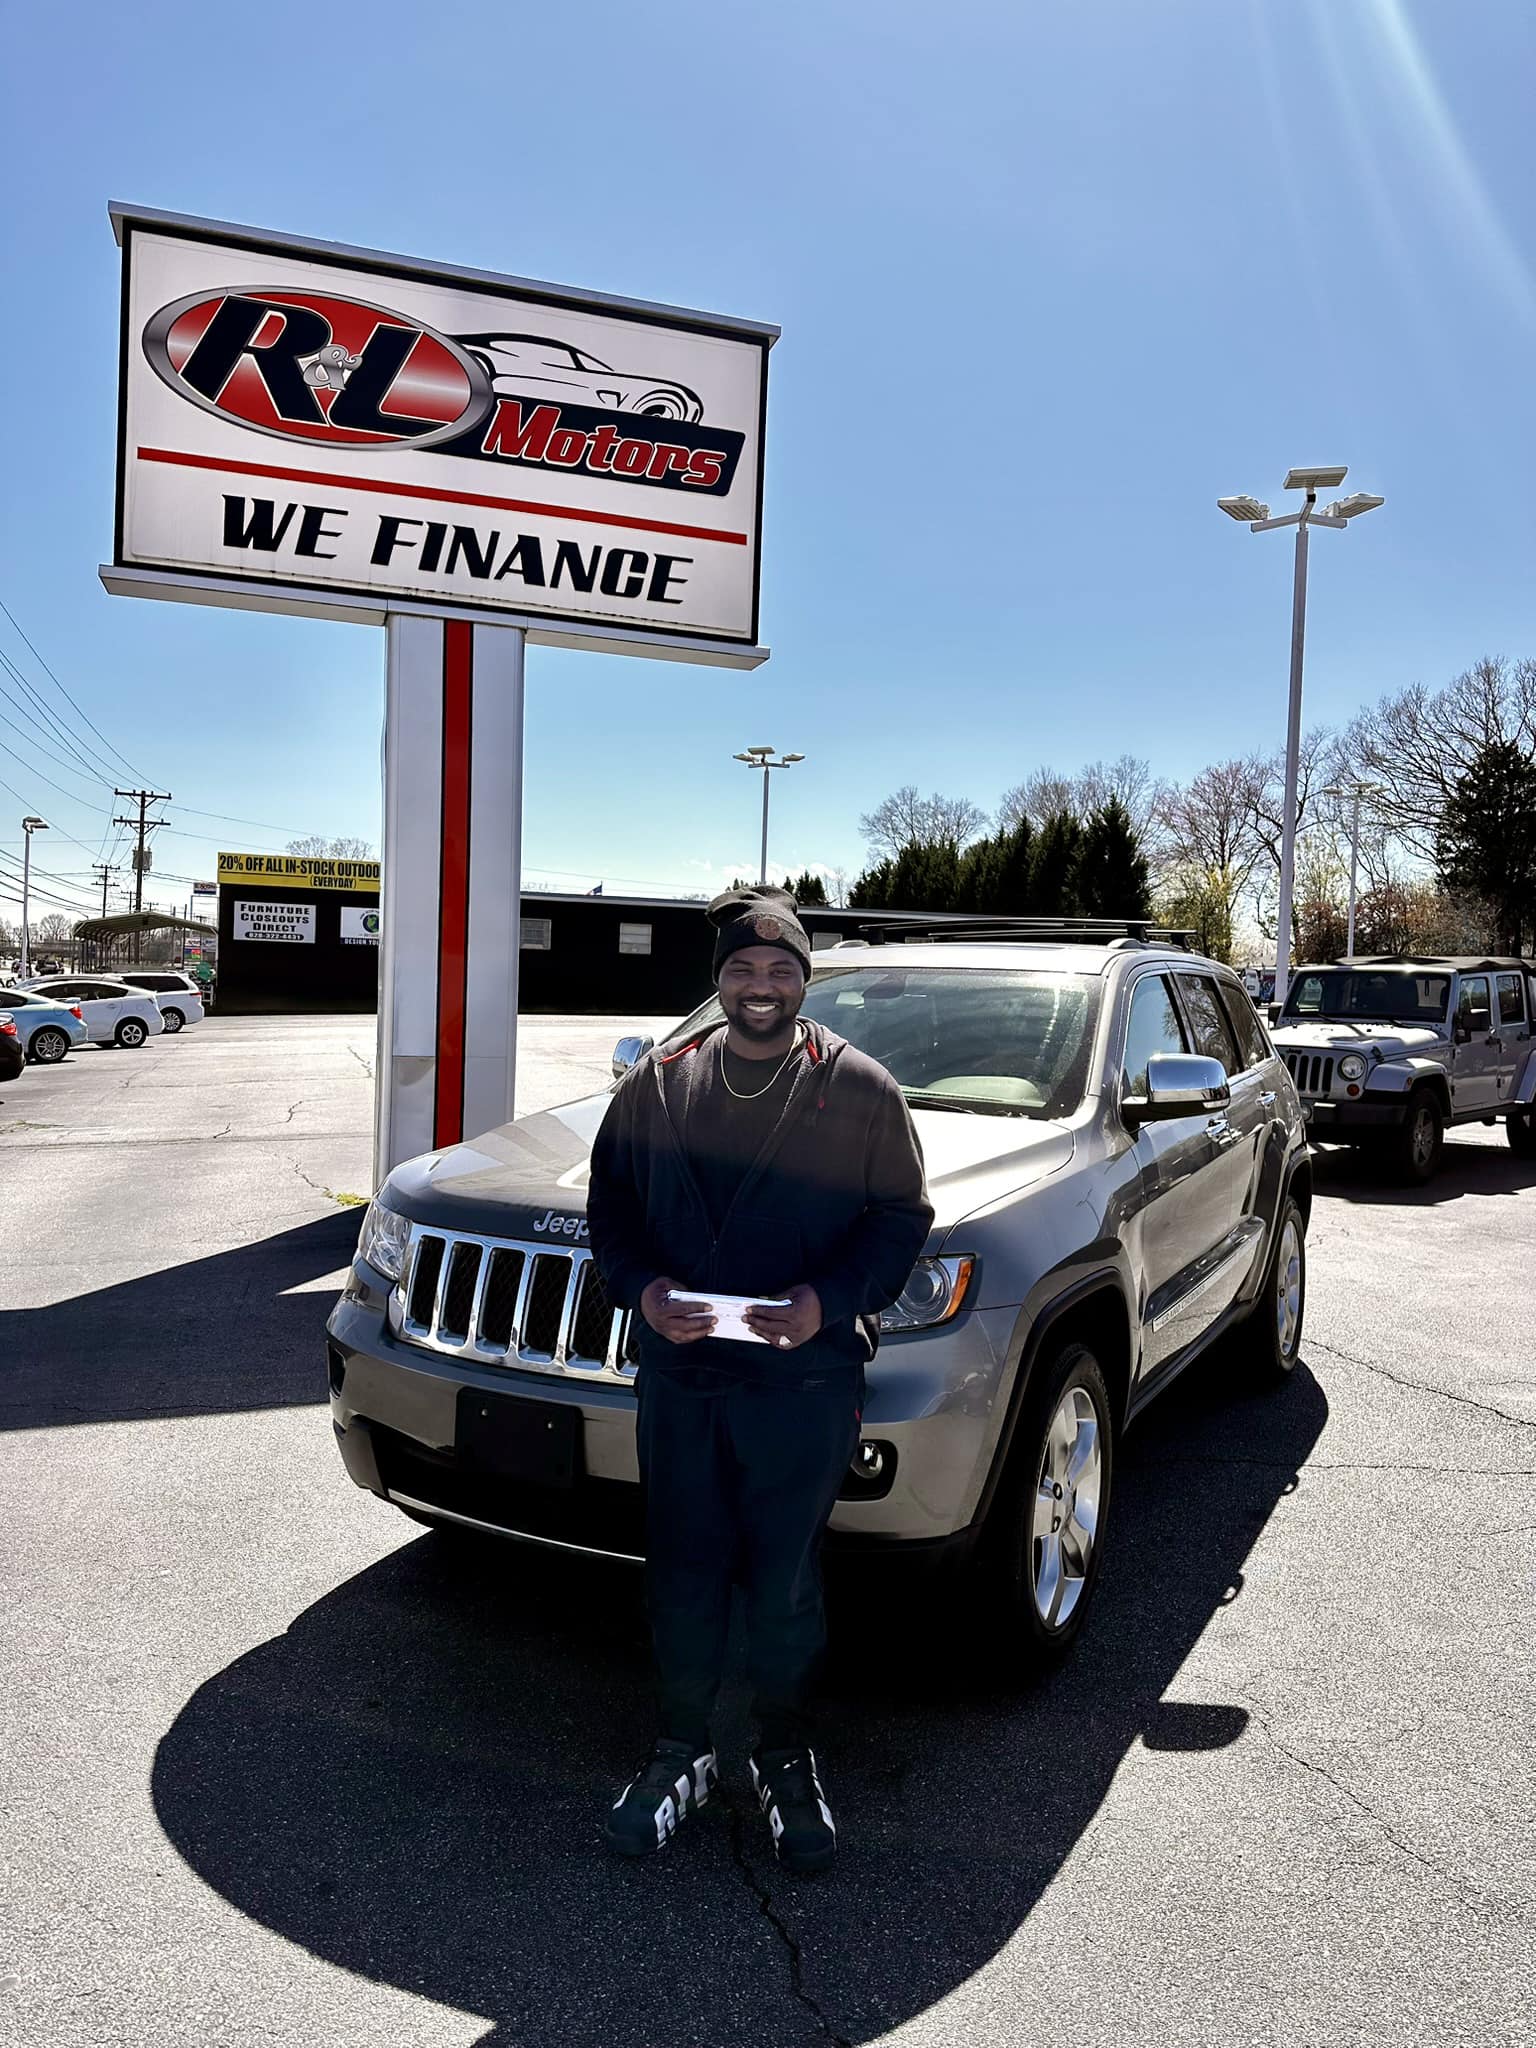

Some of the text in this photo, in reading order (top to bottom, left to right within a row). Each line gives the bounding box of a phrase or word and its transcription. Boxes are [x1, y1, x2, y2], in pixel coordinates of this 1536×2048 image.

[177, 293, 728, 487] R&L Motors
[221, 494, 694, 604] WE FINANCE
[219, 854, 243, 870] 20%
[246, 856, 265, 872] OFF
[266, 858, 283, 873] ALL
[286, 858, 336, 875] IN-STOCK
[310, 874, 357, 889] (EVERYDAY)
[240, 903, 310, 915] FURNITURE
[240, 912, 310, 924] CLOSEOUTS
[253, 922, 297, 932] DIRECT
[533, 1210, 590, 1240] Jeep
